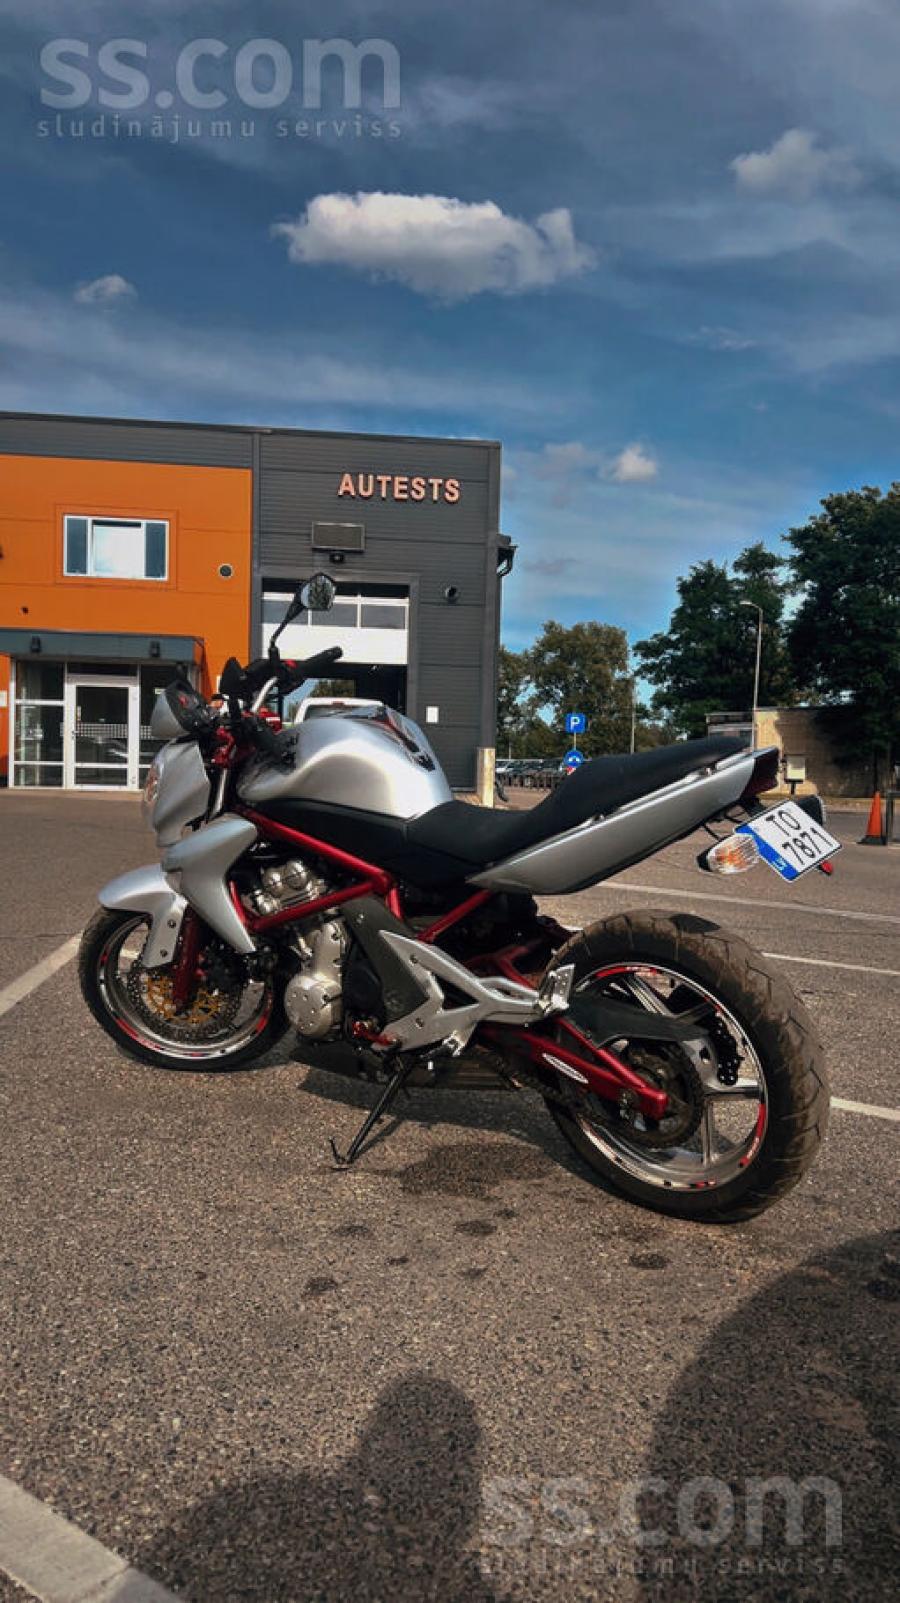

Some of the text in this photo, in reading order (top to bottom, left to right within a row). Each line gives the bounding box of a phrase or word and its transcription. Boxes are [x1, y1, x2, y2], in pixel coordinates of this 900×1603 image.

[337, 472, 462, 504] AUTESTS
[570, 716, 580, 730] P
[765, 809, 801, 837] TO
[782, 827, 834, 866] 7871
